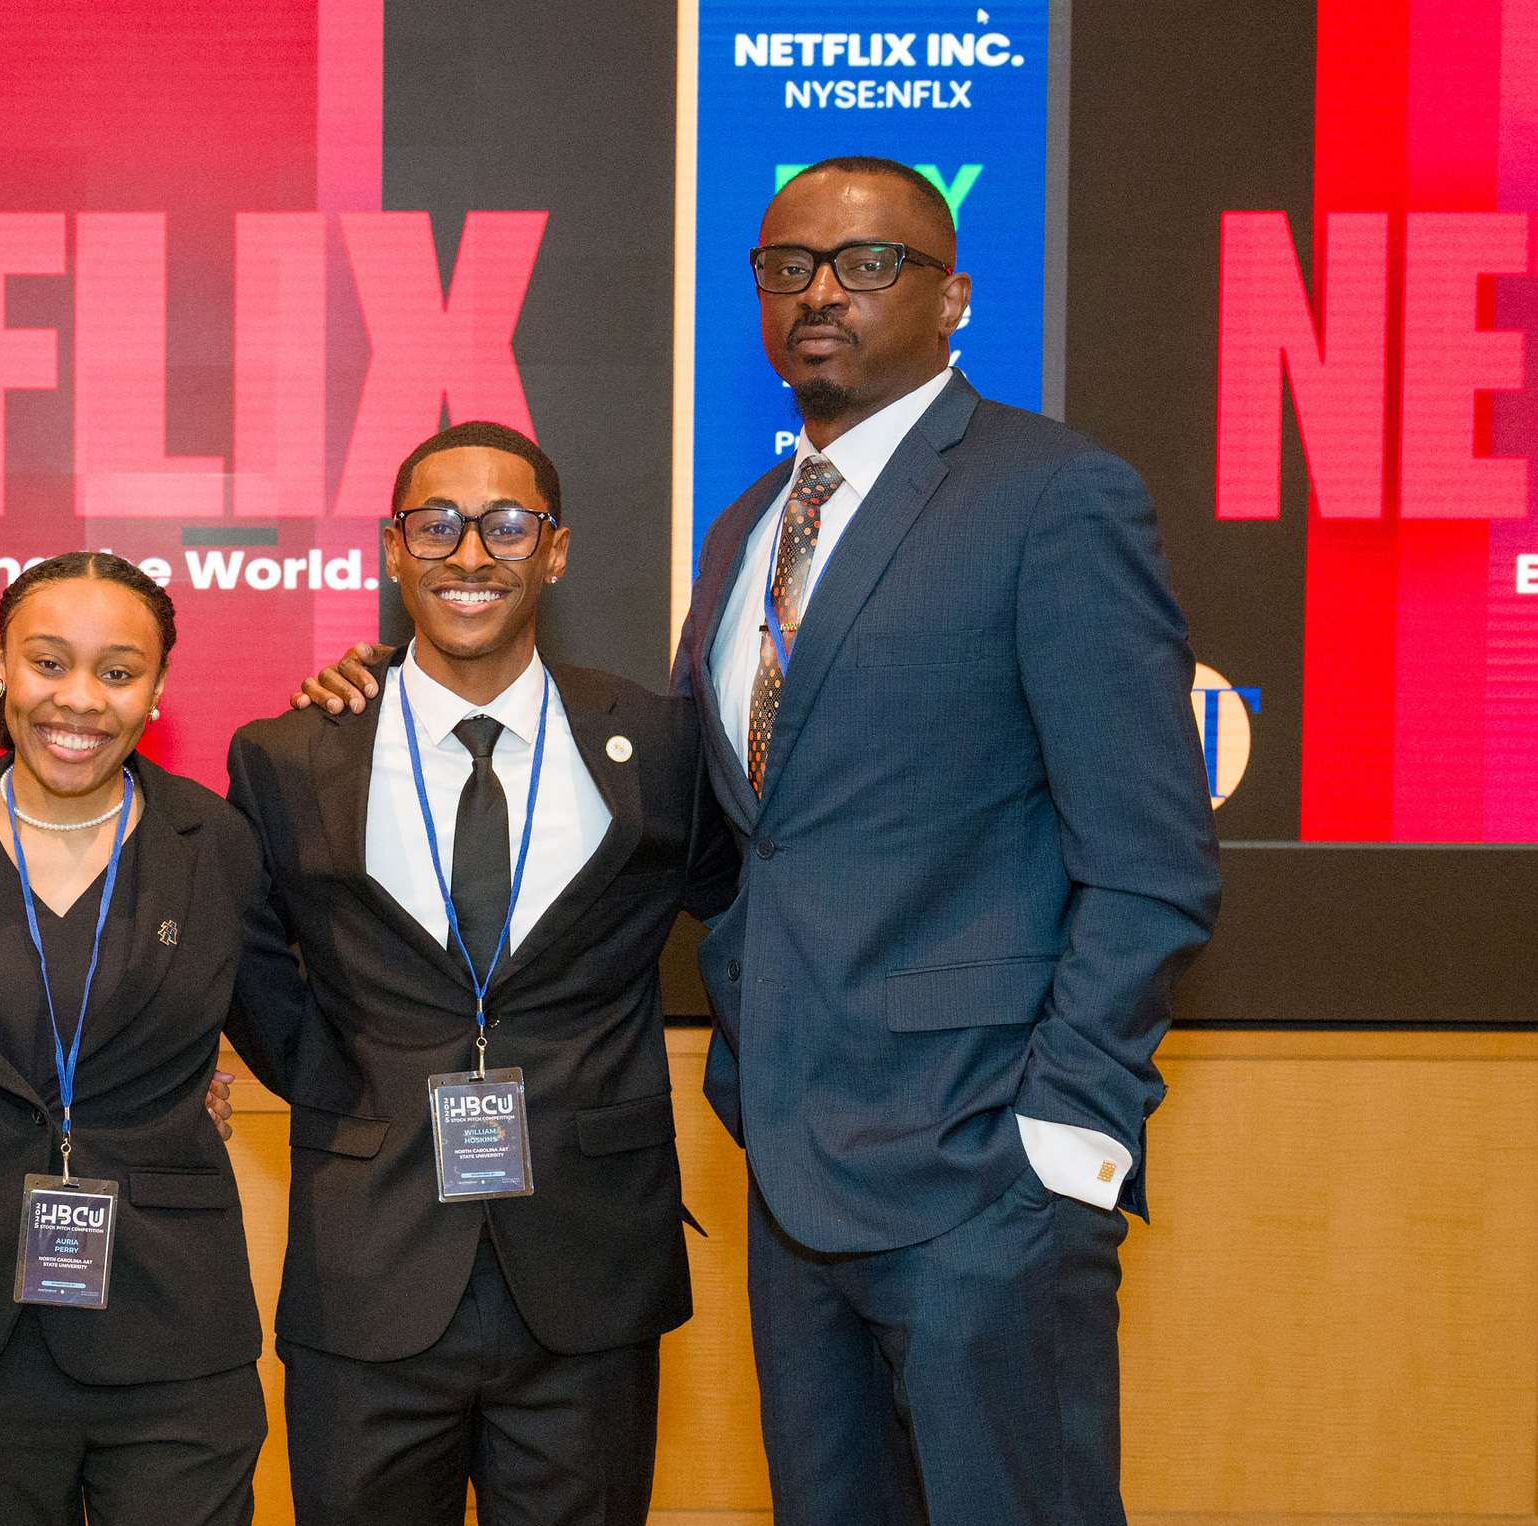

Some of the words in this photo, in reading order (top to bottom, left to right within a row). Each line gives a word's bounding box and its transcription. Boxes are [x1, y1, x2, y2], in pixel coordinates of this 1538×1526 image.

[734, 33, 917, 67] NETFLIX
[927, 33, 1025, 67] INC.
[785, 80, 972, 109] NYSE:NFLX
[184, 549, 380, 590] World.
[450, 1094, 513, 1117] HBCU
[464, 1128, 497, 1136] WILLIAM
[41, 1203, 105, 1227] HBCU
[55, 1238, 79, 1246] AURIA
